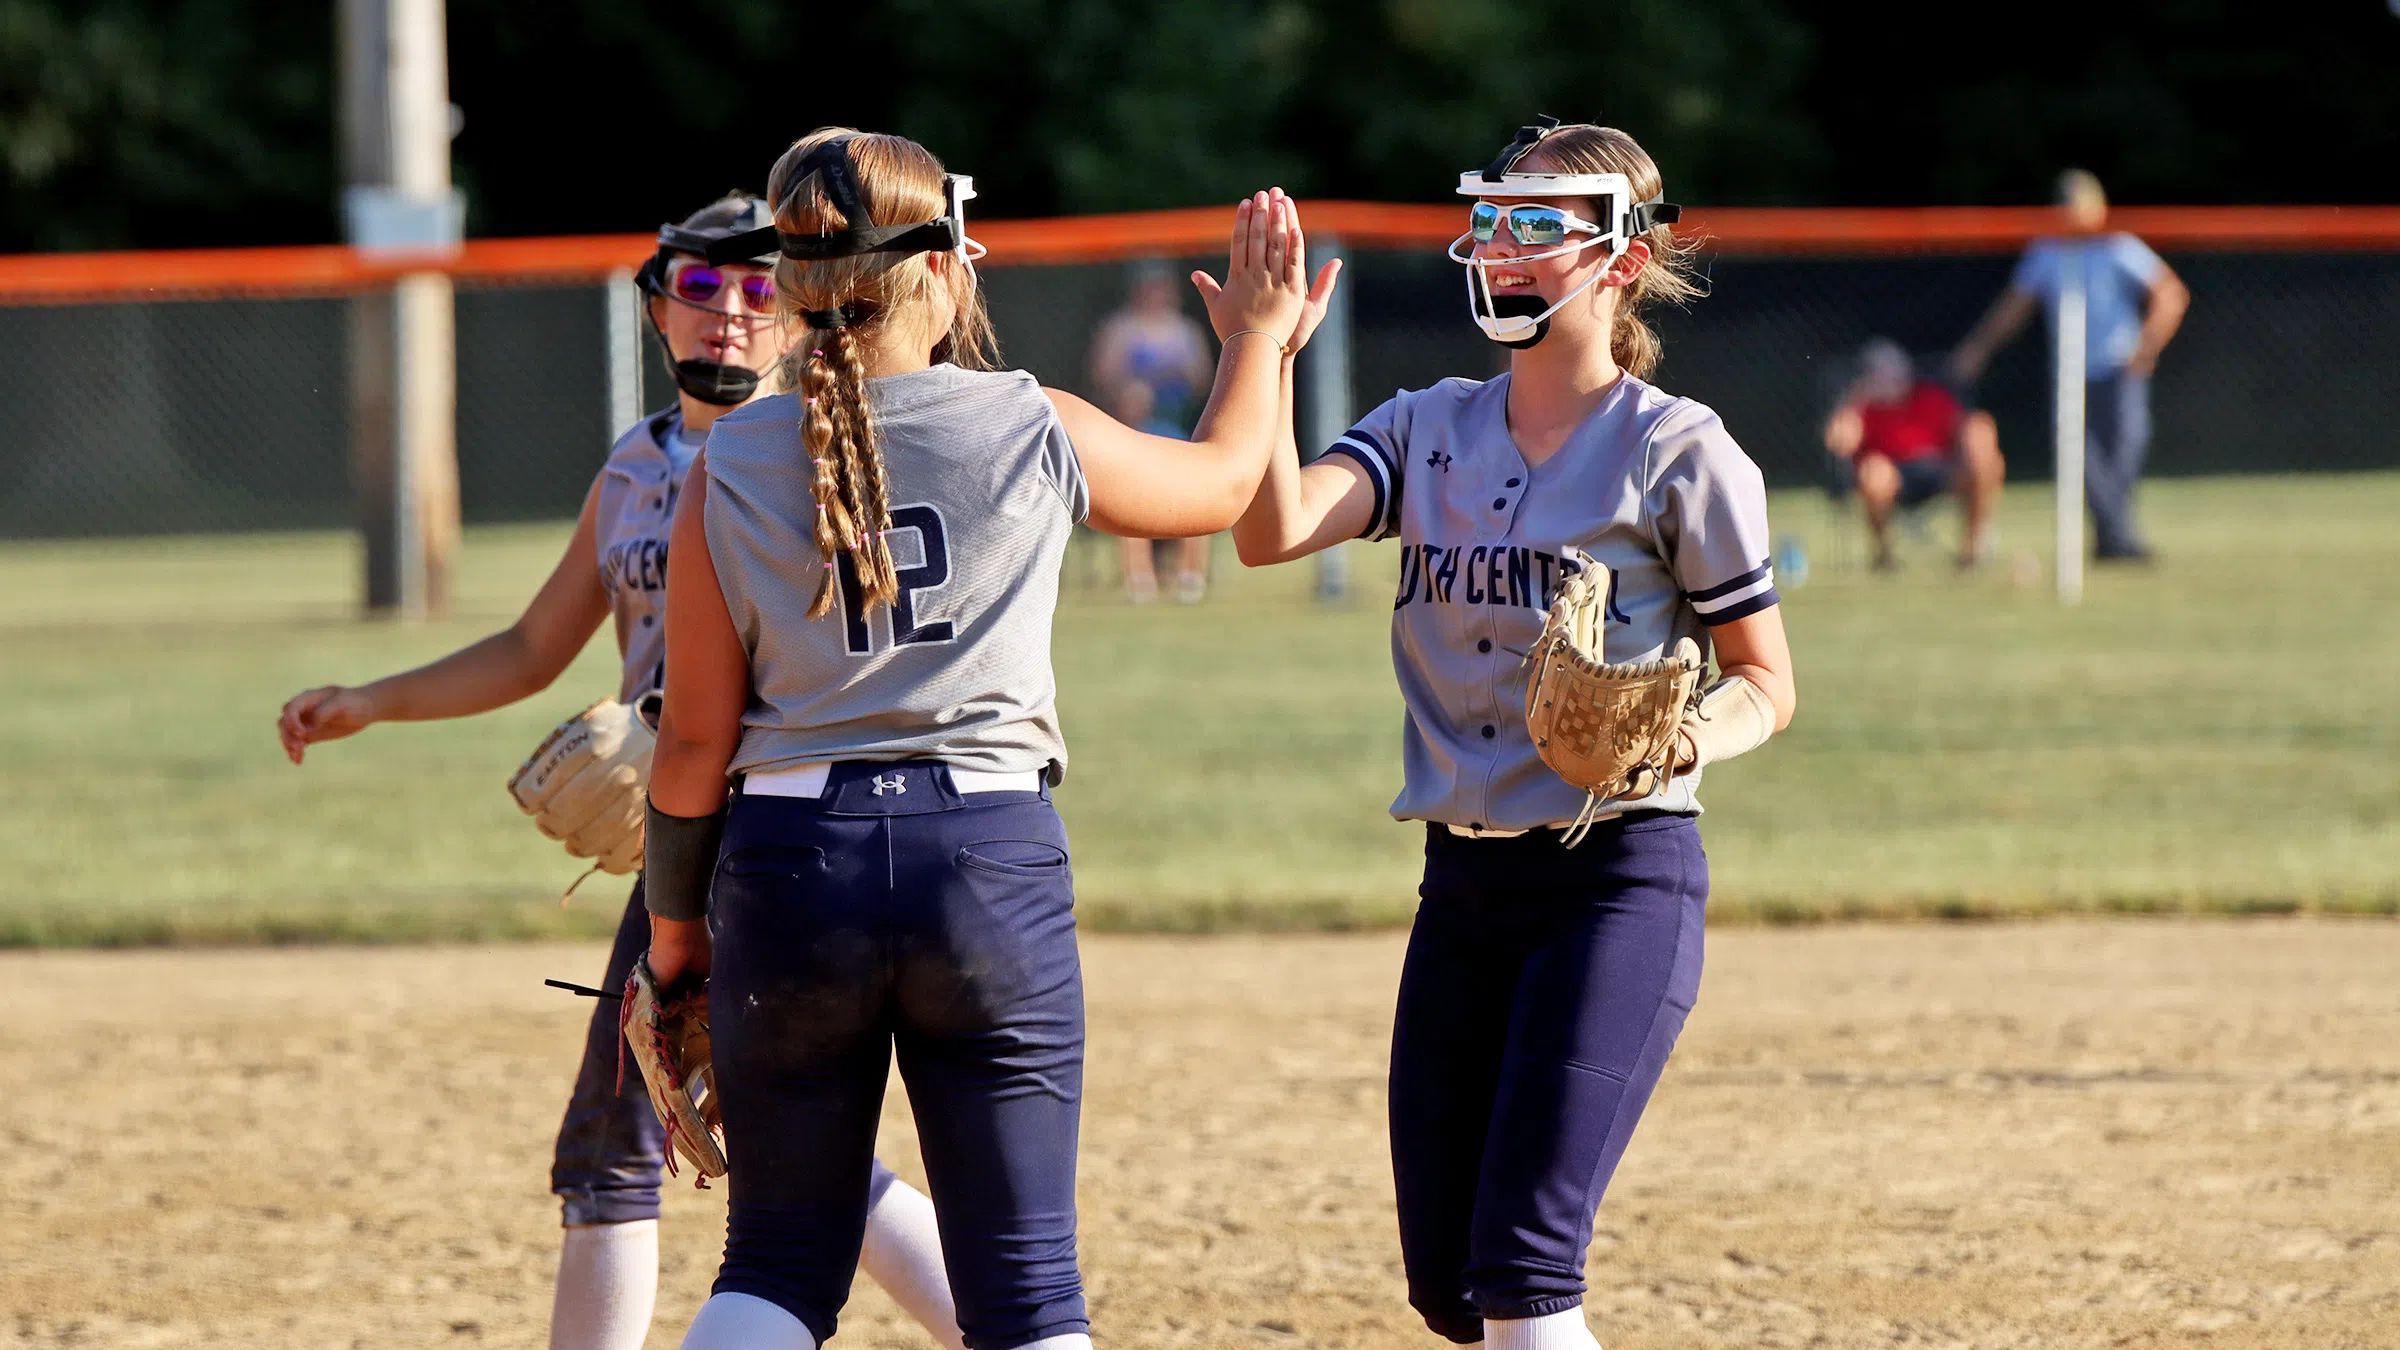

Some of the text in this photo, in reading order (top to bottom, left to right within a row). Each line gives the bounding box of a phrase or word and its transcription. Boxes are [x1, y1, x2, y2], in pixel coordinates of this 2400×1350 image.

[835, 502, 958, 656] 12
[1394, 544, 1631, 626] UTH CENTL
[536, 730, 589, 787] EASTON
